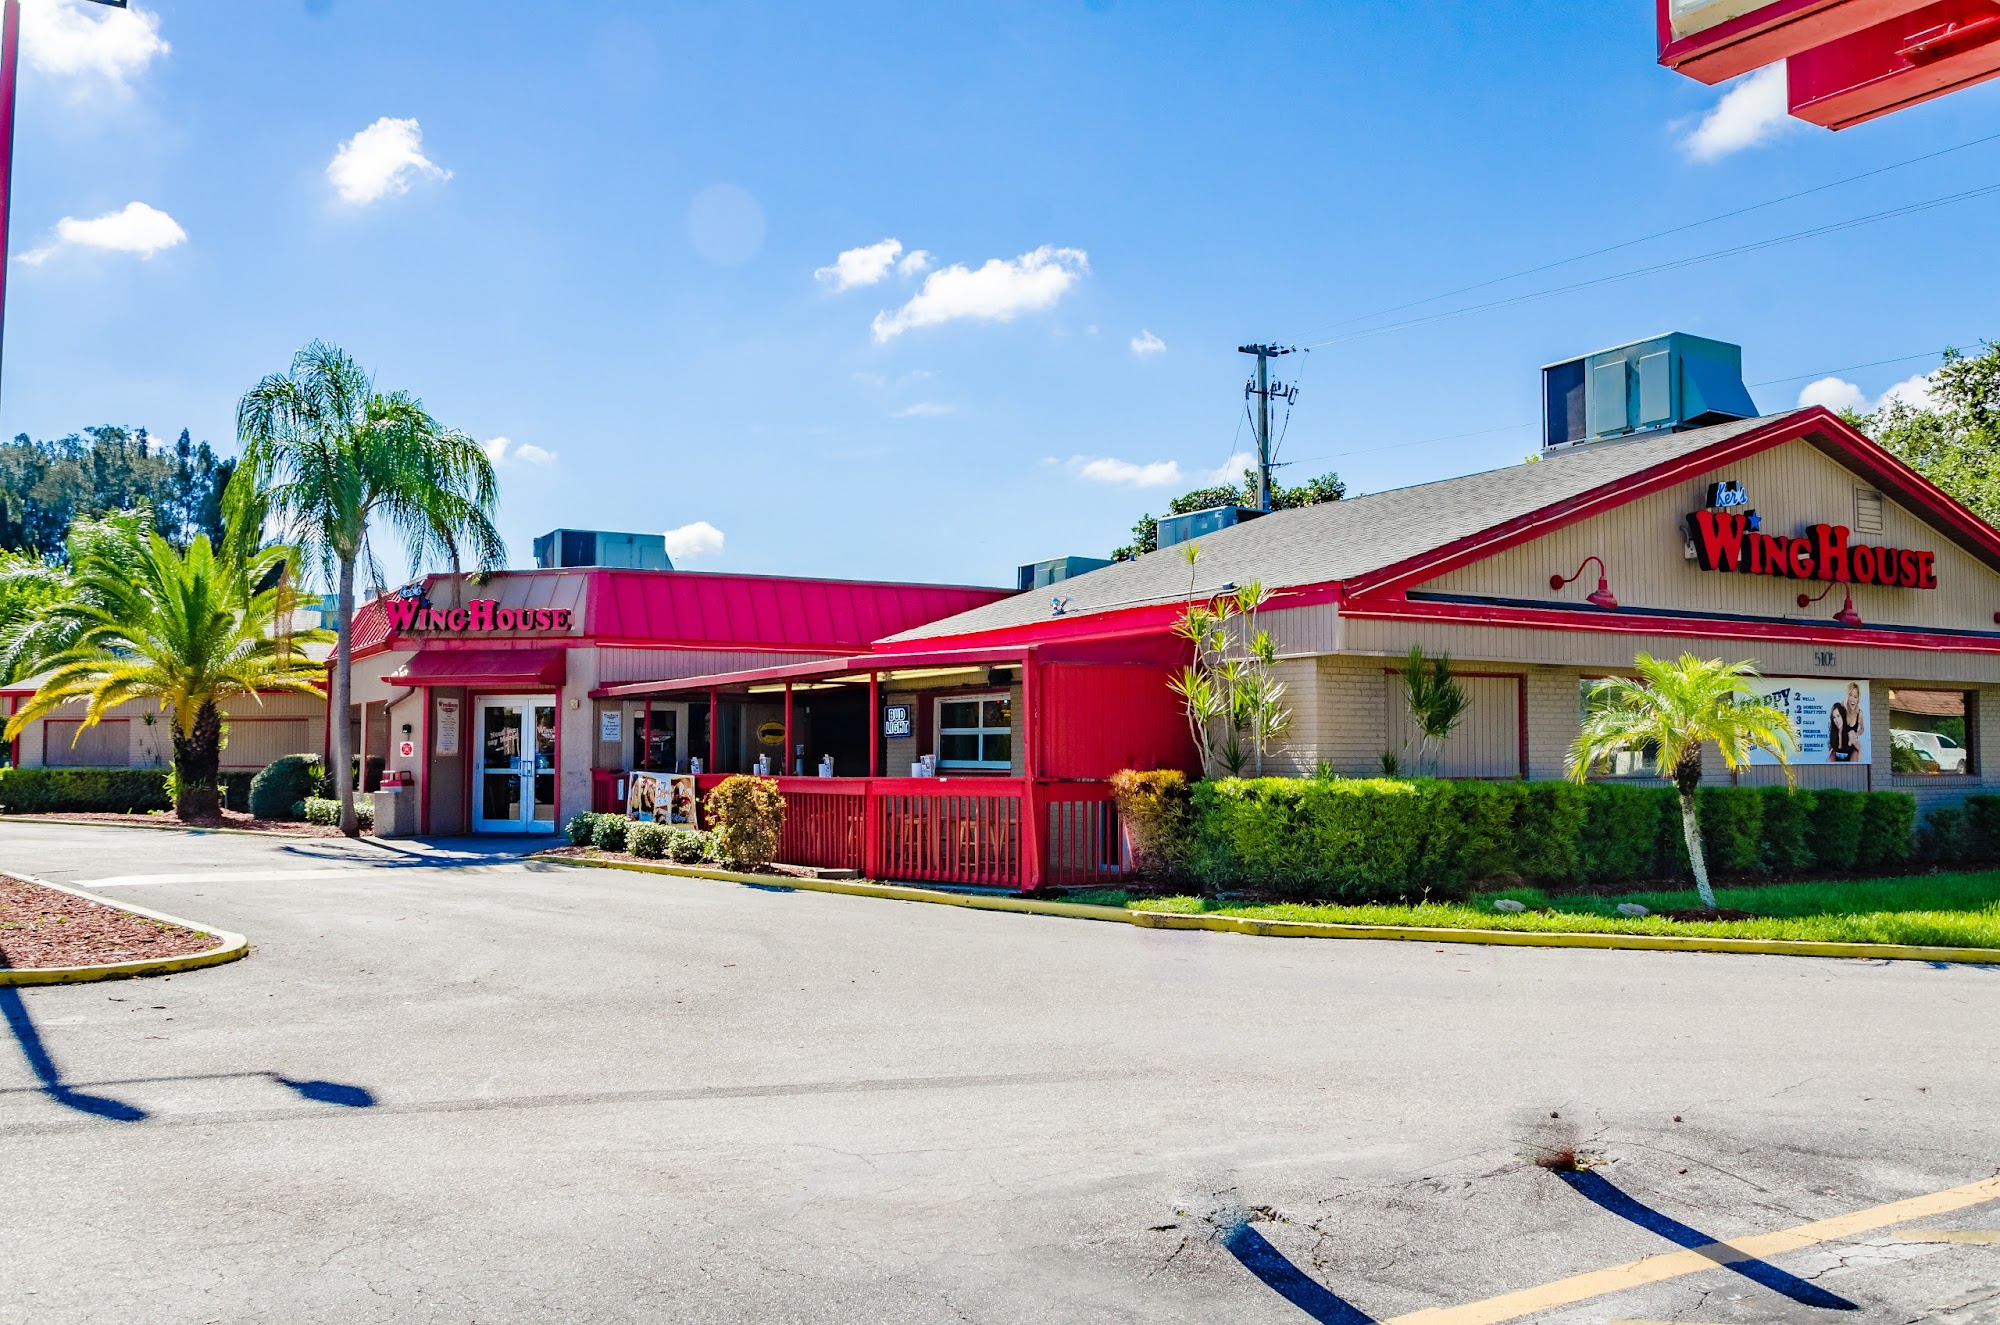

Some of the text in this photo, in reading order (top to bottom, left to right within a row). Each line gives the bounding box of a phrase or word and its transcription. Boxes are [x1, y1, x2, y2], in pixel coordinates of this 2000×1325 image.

[1716, 480, 1748, 507] Ker's
[1814, 651, 1836, 667] 5105
[888, 708, 906, 721] BUD
[886, 721, 909, 734] LIGHT
